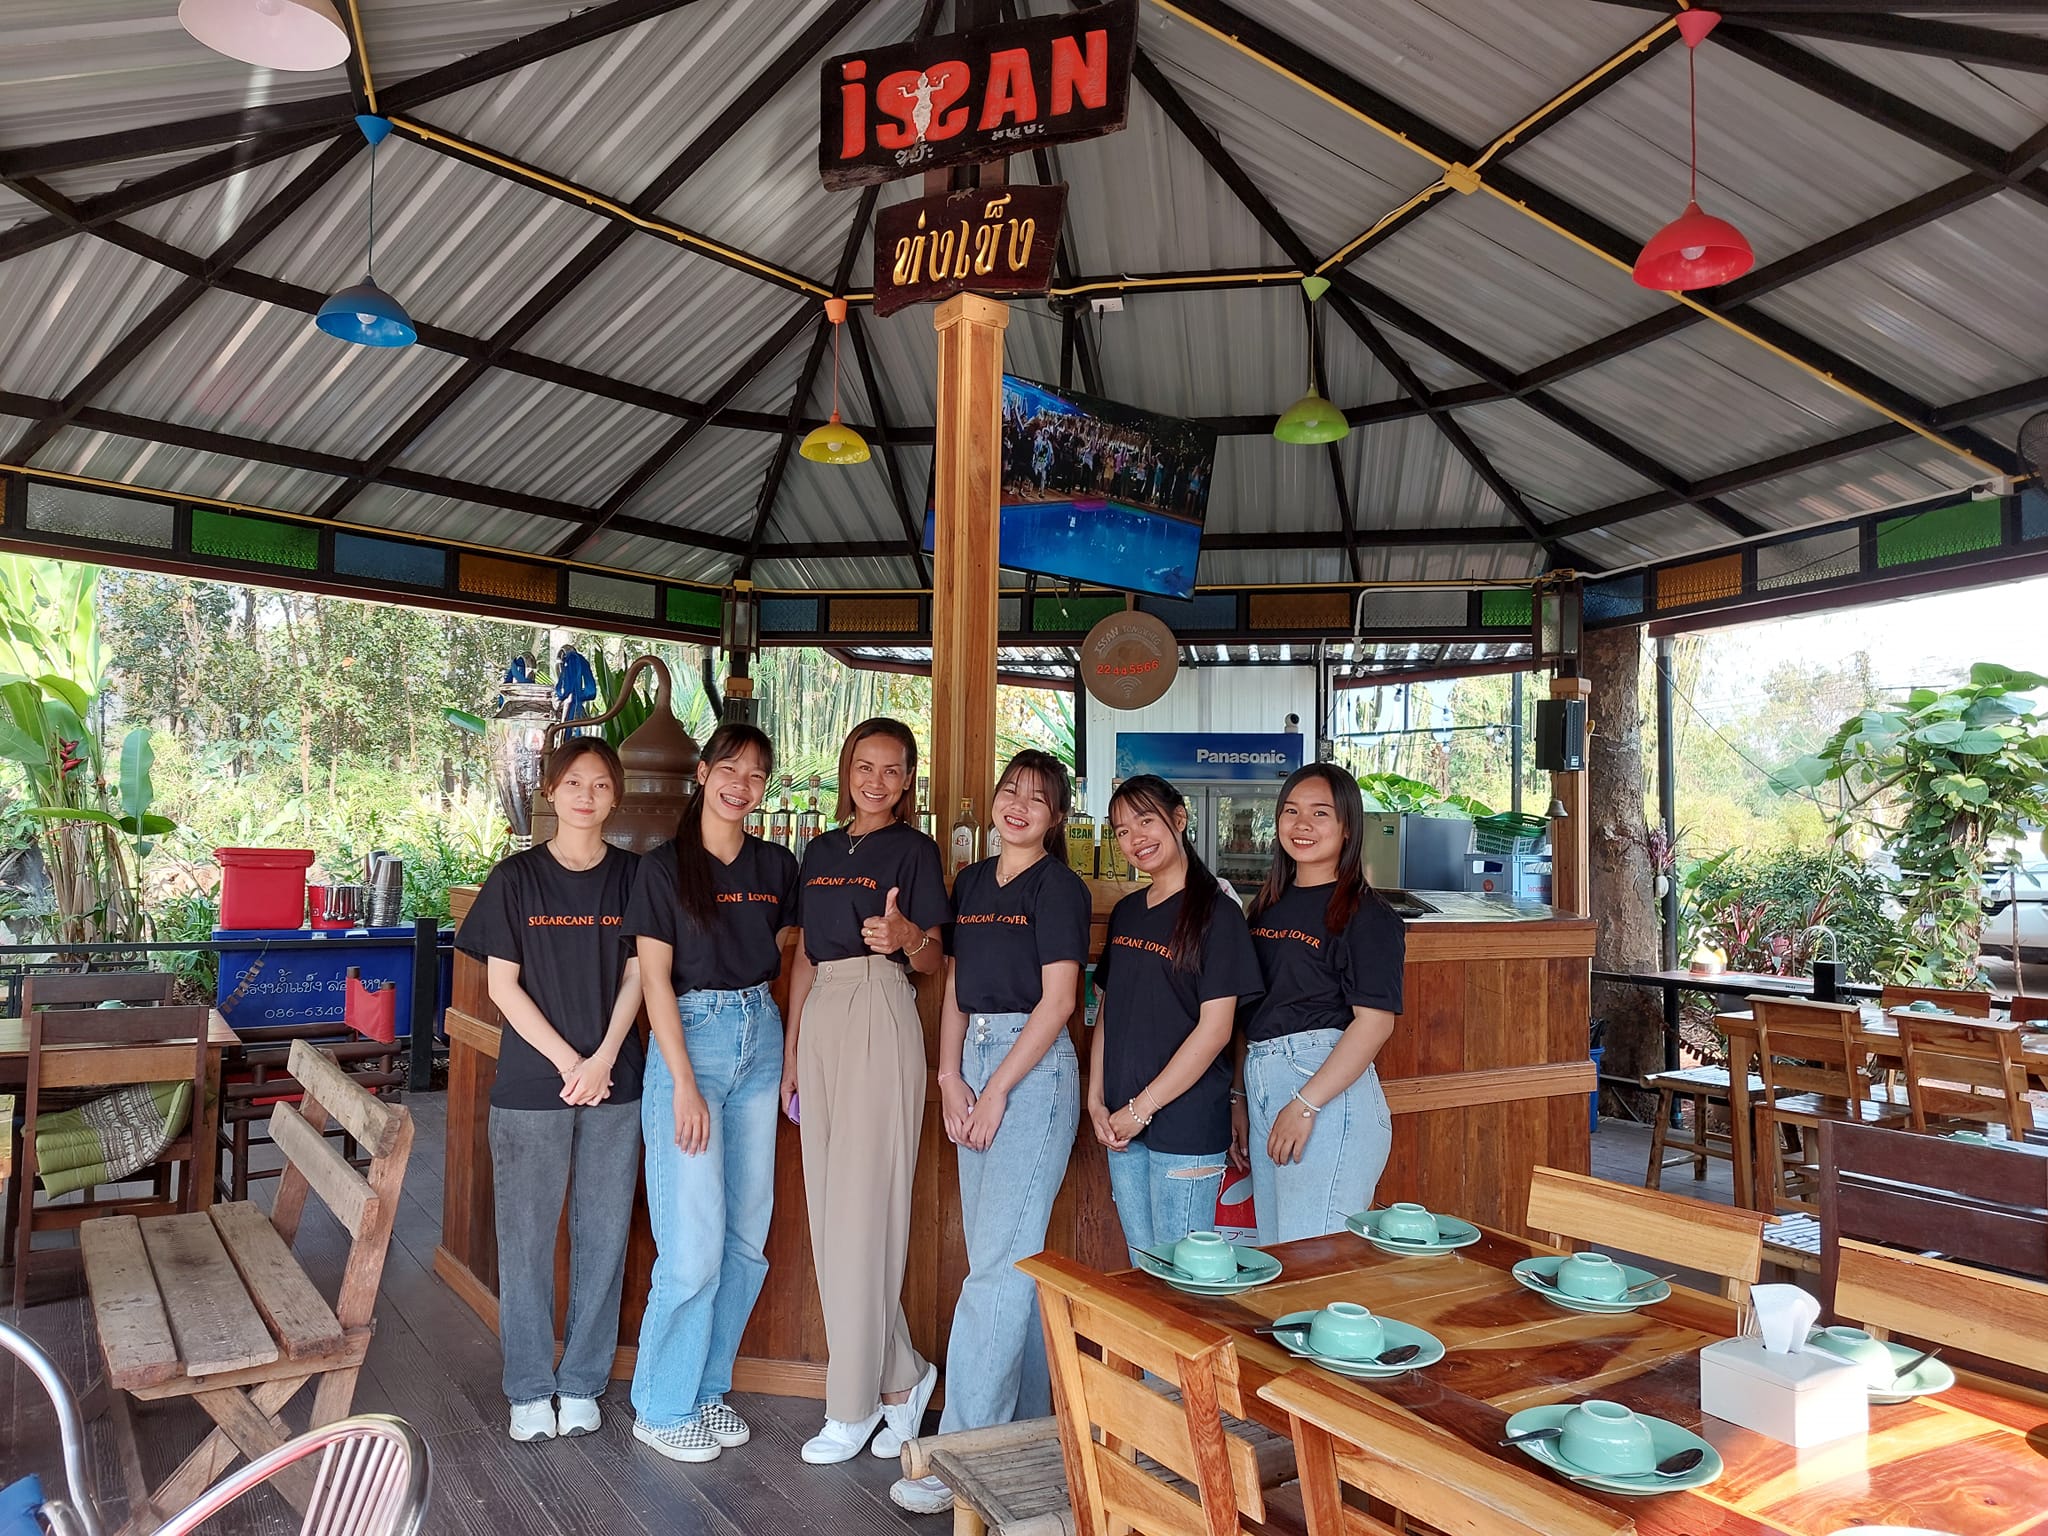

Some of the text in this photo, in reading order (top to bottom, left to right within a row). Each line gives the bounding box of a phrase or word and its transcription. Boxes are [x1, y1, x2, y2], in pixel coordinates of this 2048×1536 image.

[1196, 748, 1287, 765] Panasonic
[747, 891, 779, 904] LOVER
[528, 915, 595, 926] SUGARCANE
[997, 914, 1029, 926] LOVER
[1288, 929, 1321, 949] LOVER
[1144, 940, 1174, 960] LOVER
[264, 1006, 347, 1019] 086-6340
